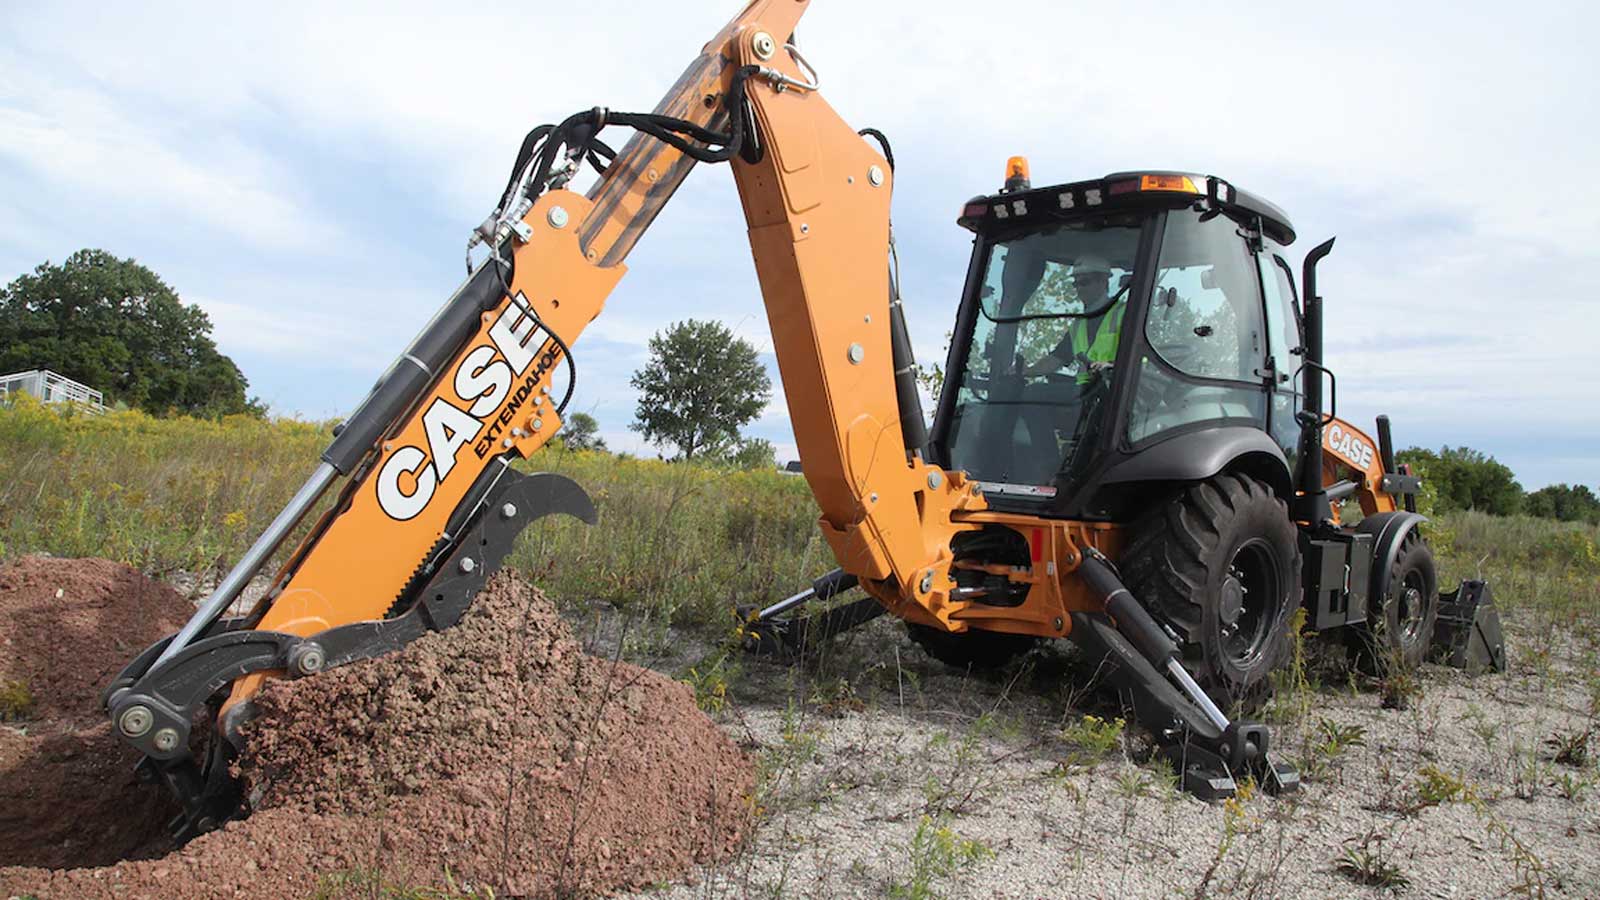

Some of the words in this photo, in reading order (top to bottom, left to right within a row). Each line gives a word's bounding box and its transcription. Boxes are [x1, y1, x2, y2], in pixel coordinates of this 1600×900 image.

[376, 289, 550, 521] CASE
[474, 340, 562, 460] EXTENDAHOE
[1328, 424, 1373, 470] CASE
